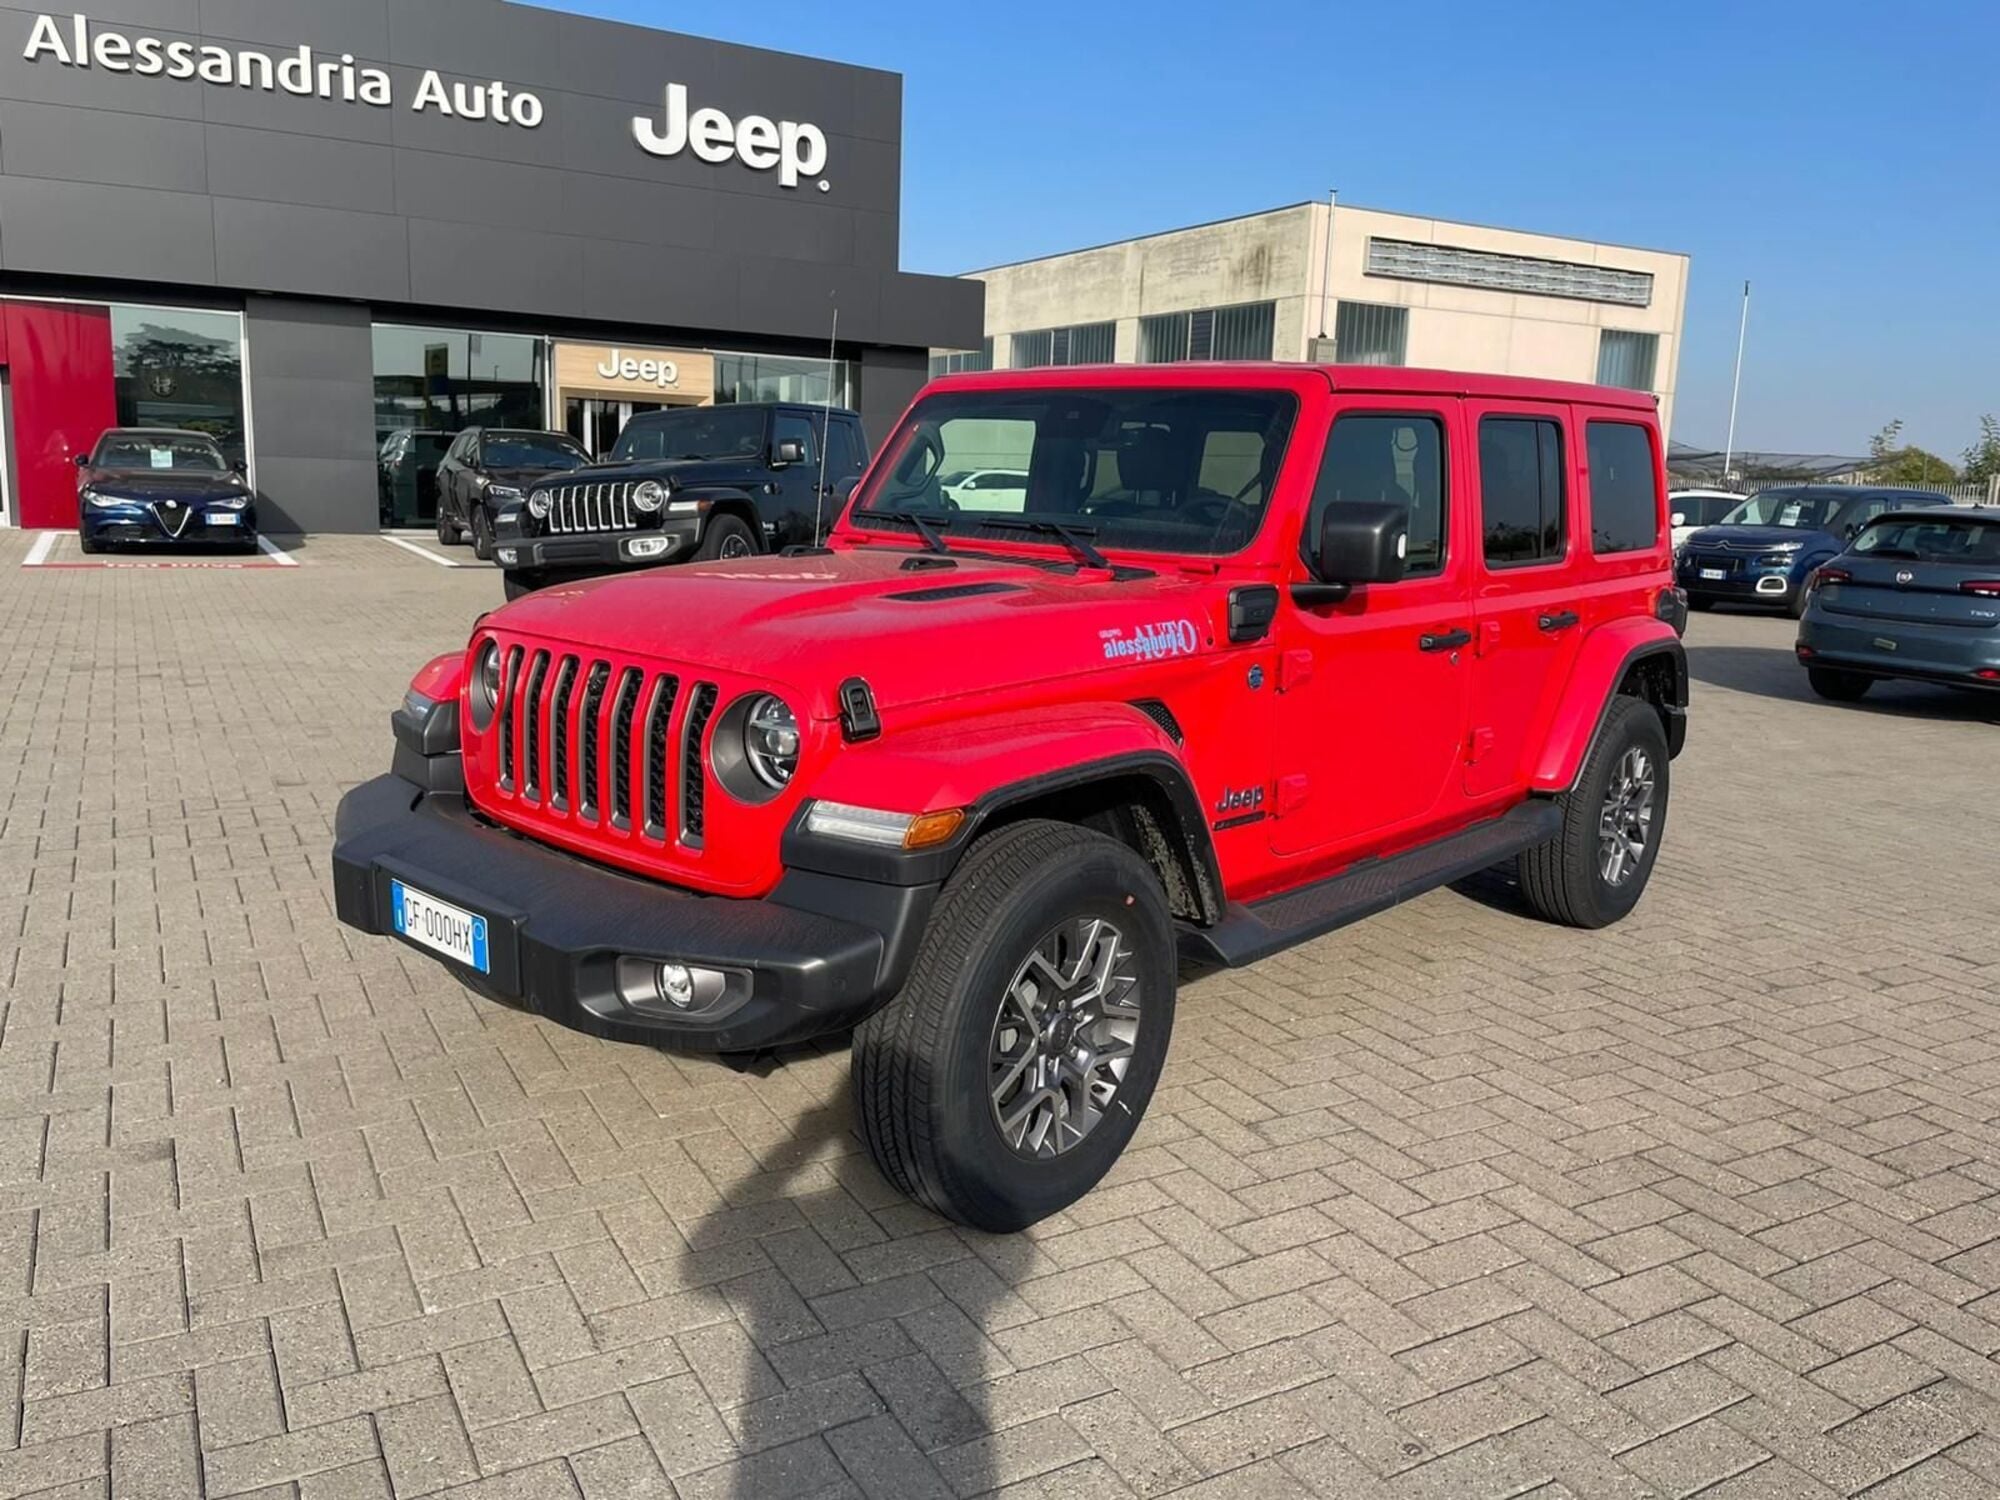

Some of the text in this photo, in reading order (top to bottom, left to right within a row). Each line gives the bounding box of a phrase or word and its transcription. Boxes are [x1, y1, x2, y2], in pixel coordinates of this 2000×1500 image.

[23, 14, 544, 128] Alessandria Auto
[633, 83, 827, 188] Jeep
[597, 349, 678, 388] Jeep
[1215, 785, 1264, 812] Jeep
